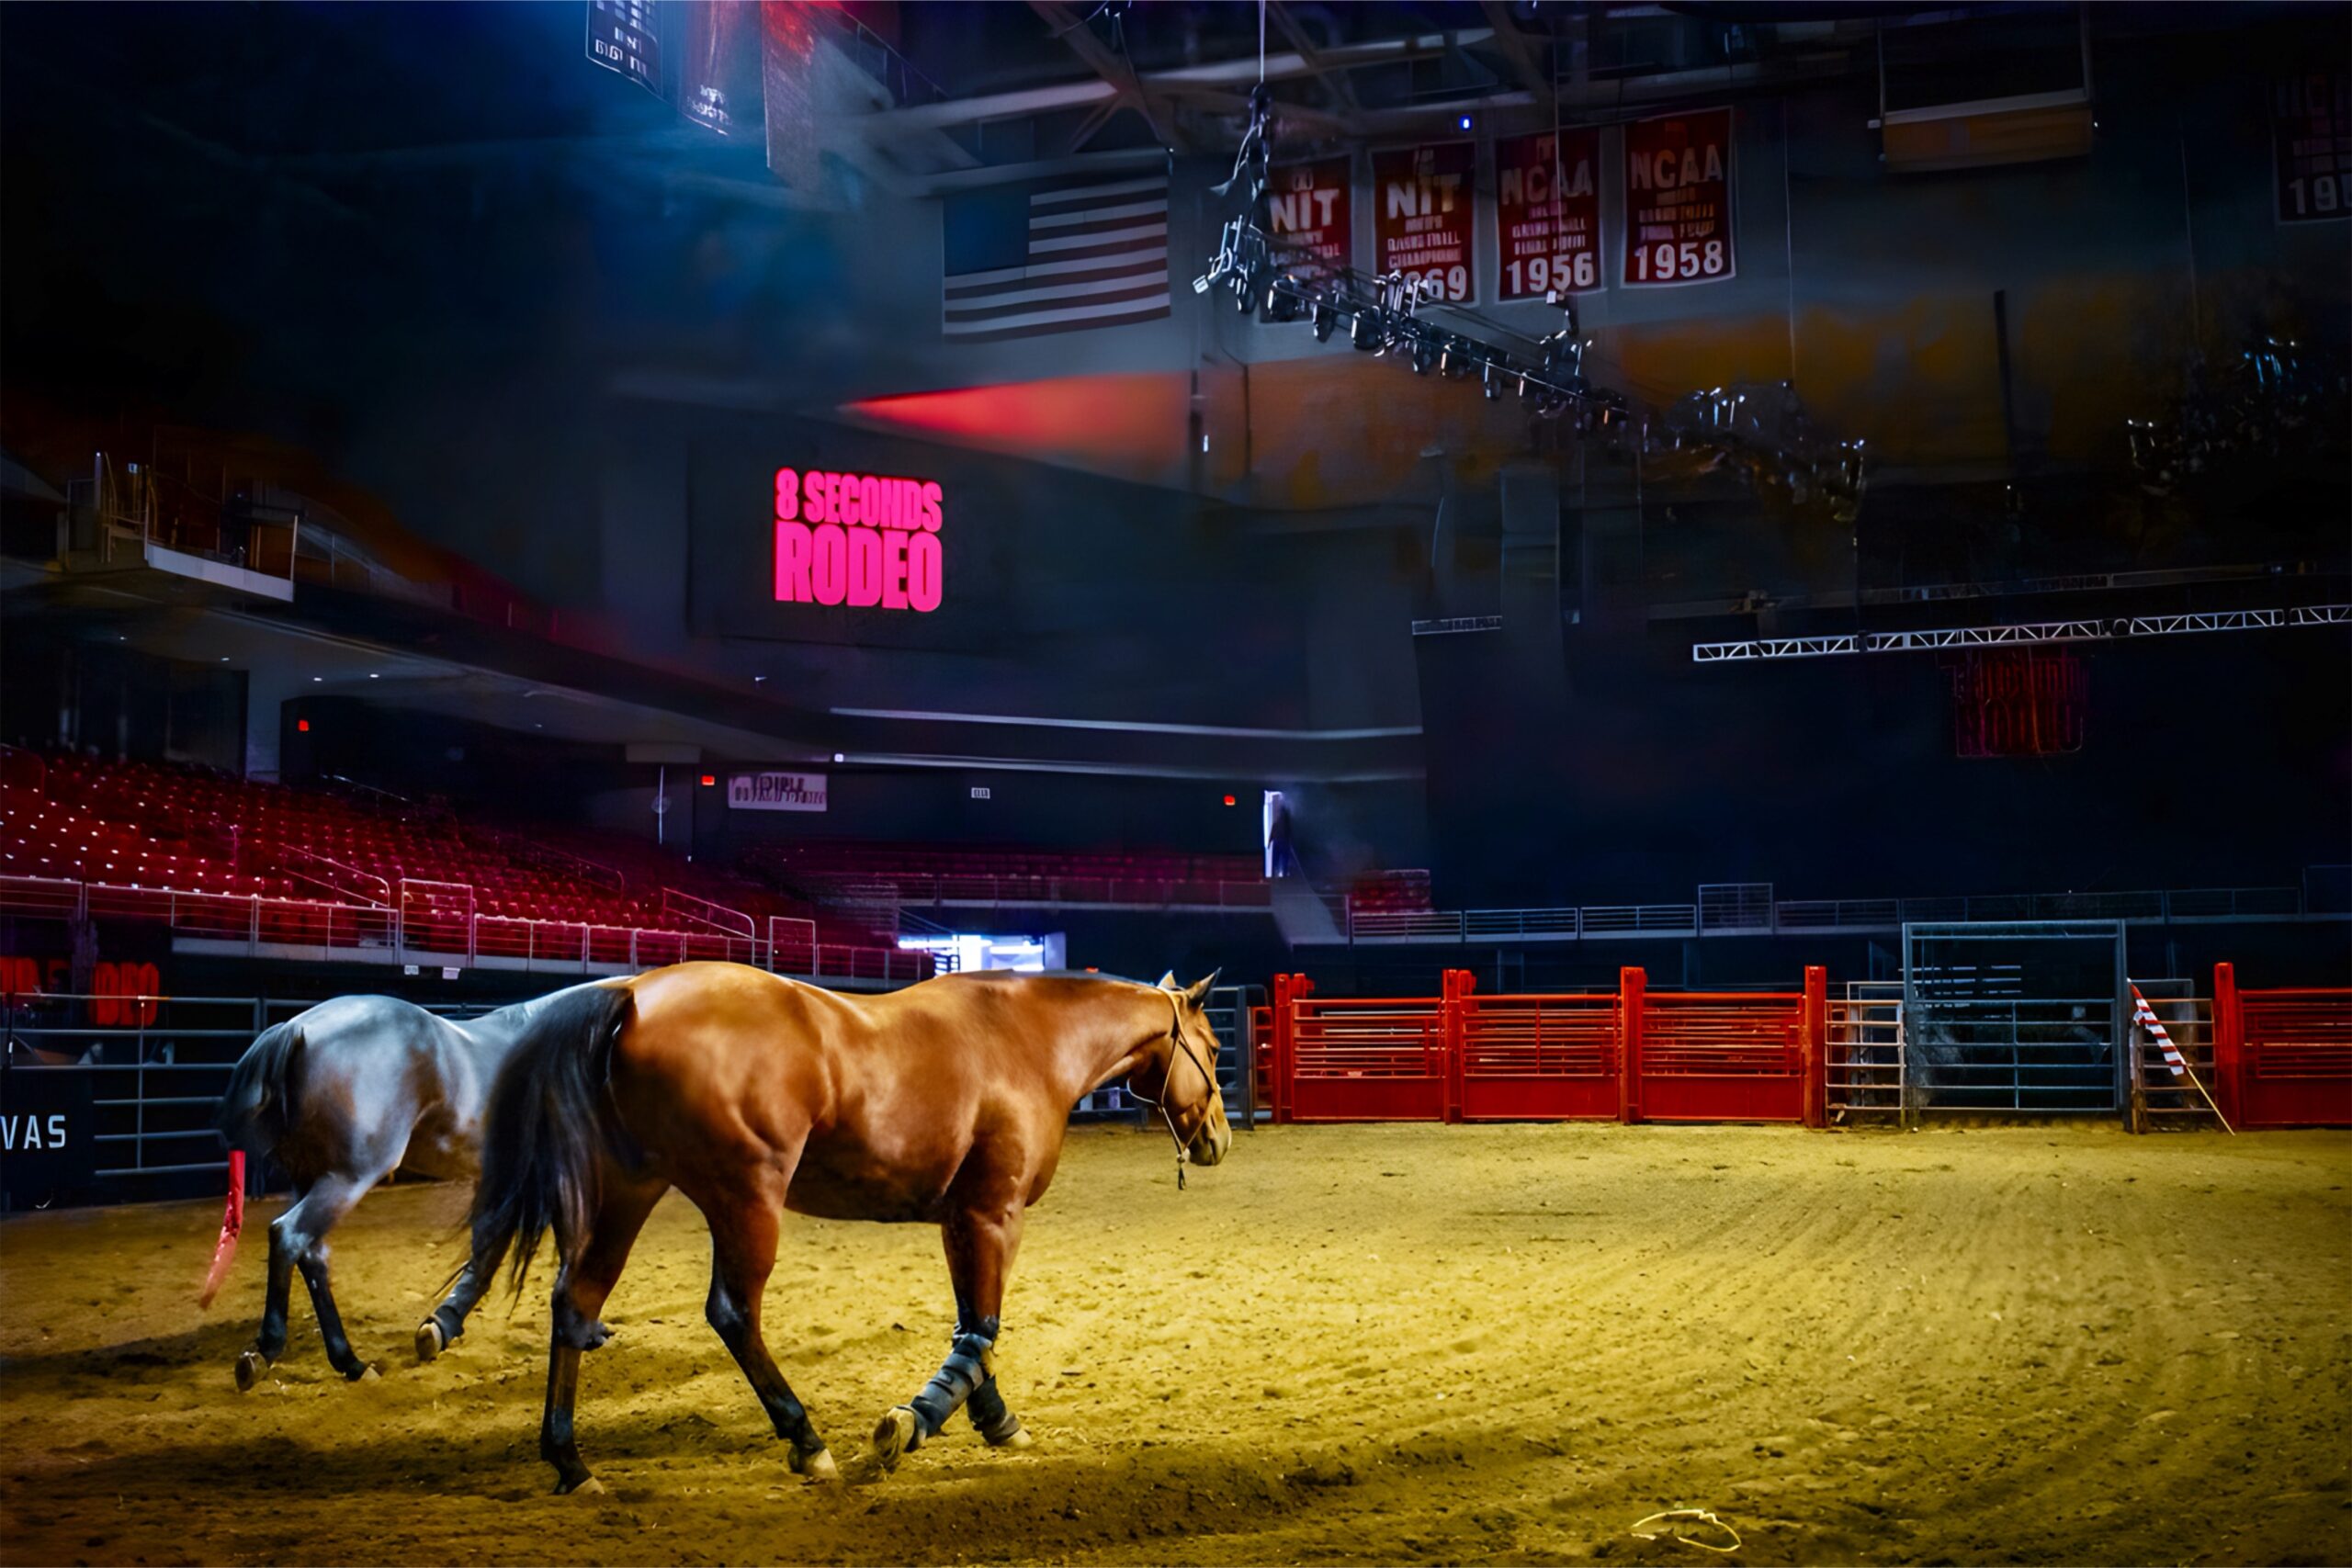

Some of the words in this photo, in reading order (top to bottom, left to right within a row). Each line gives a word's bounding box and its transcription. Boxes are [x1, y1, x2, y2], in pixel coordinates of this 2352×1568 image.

[1500, 159, 1593, 206] NCAA
[1631, 144, 1724, 189] NCAA
[1269, 187, 1340, 233] NIT
[1387, 173, 1462, 220] NIT
[1398, 265, 1467, 301] 69
[1506, 252, 1595, 295] 1956
[1634, 240, 1724, 281] 1958
[775, 467, 799, 521] 8
[804, 470, 944, 533] SECONDS
[775, 519, 943, 614] RODEO
[0, 1114, 66, 1150] VAS
